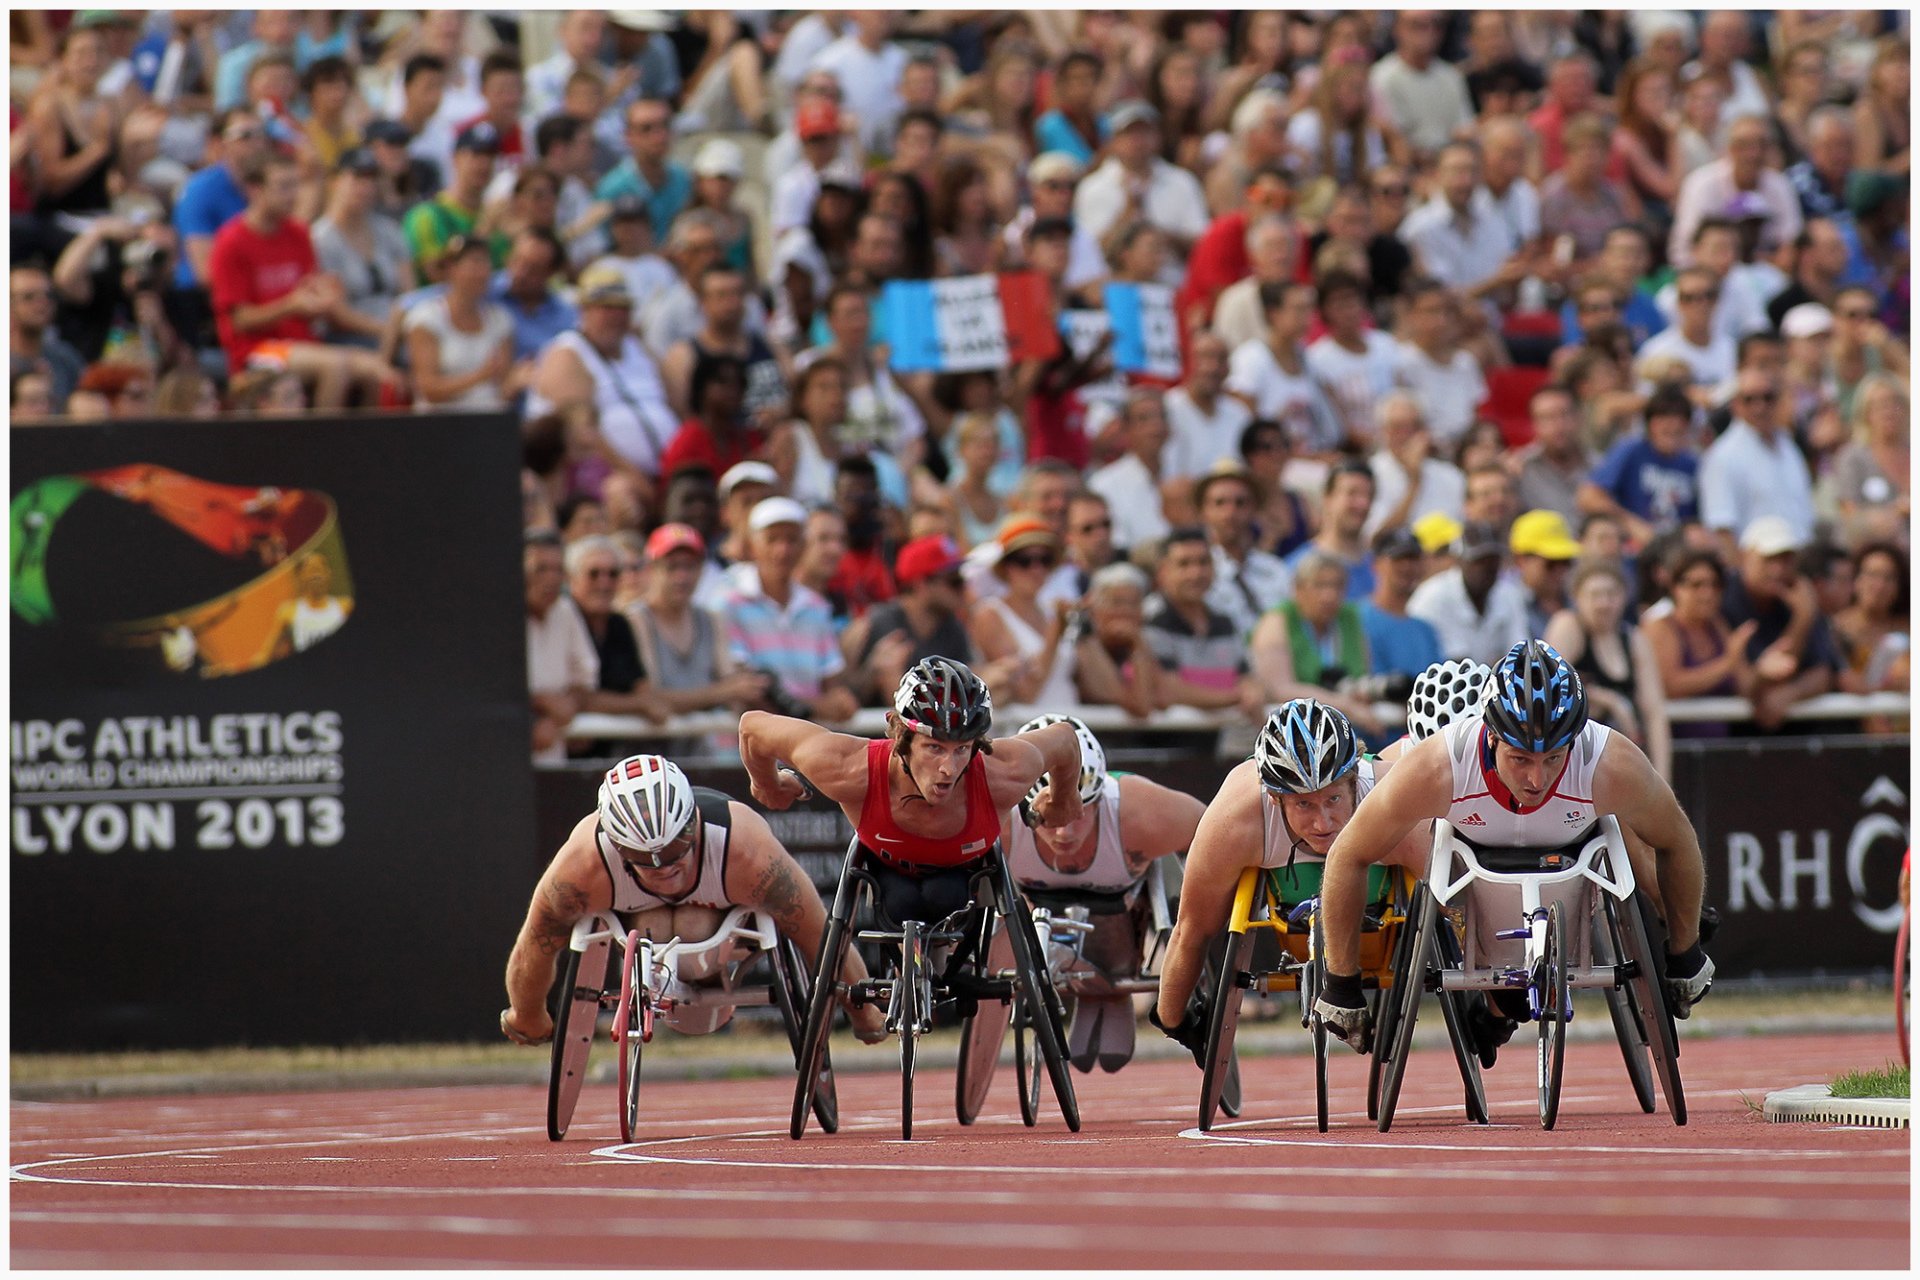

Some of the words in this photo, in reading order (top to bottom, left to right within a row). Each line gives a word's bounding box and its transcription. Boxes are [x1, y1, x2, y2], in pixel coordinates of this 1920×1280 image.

[11, 718, 86, 760] IPC
[94, 711, 344, 757] ATHLETICS
[12, 759, 116, 790] WORLD
[119, 754, 344, 786] CHAMPIONSHIPS
[11, 802, 176, 853] LYON
[196, 797, 345, 850] 2013
